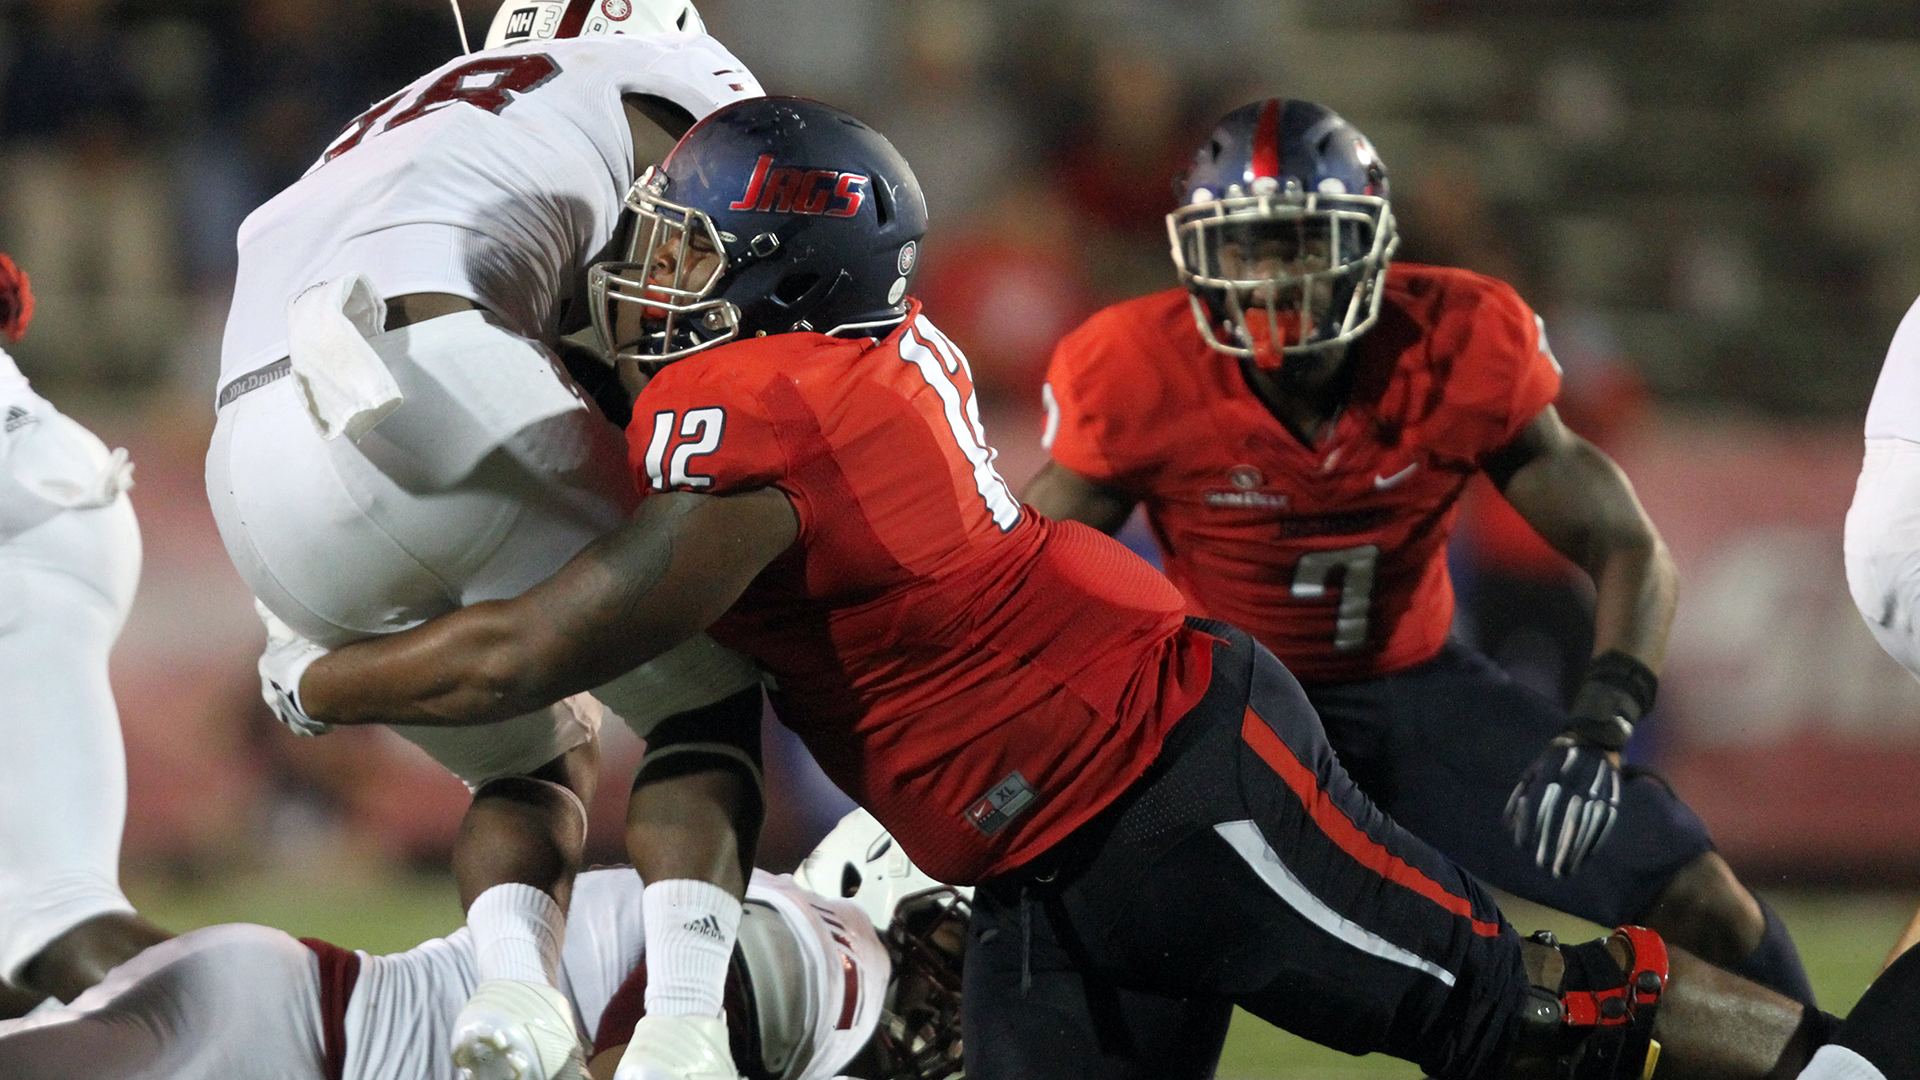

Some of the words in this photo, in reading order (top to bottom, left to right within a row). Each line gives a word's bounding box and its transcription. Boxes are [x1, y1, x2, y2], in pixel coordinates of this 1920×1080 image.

[508, 12, 534, 34] NH
[729, 154, 868, 218] JAGS
[644, 405, 727, 490] 12
[1291, 544, 1380, 649] 7
[995, 786, 1016, 803] XL
